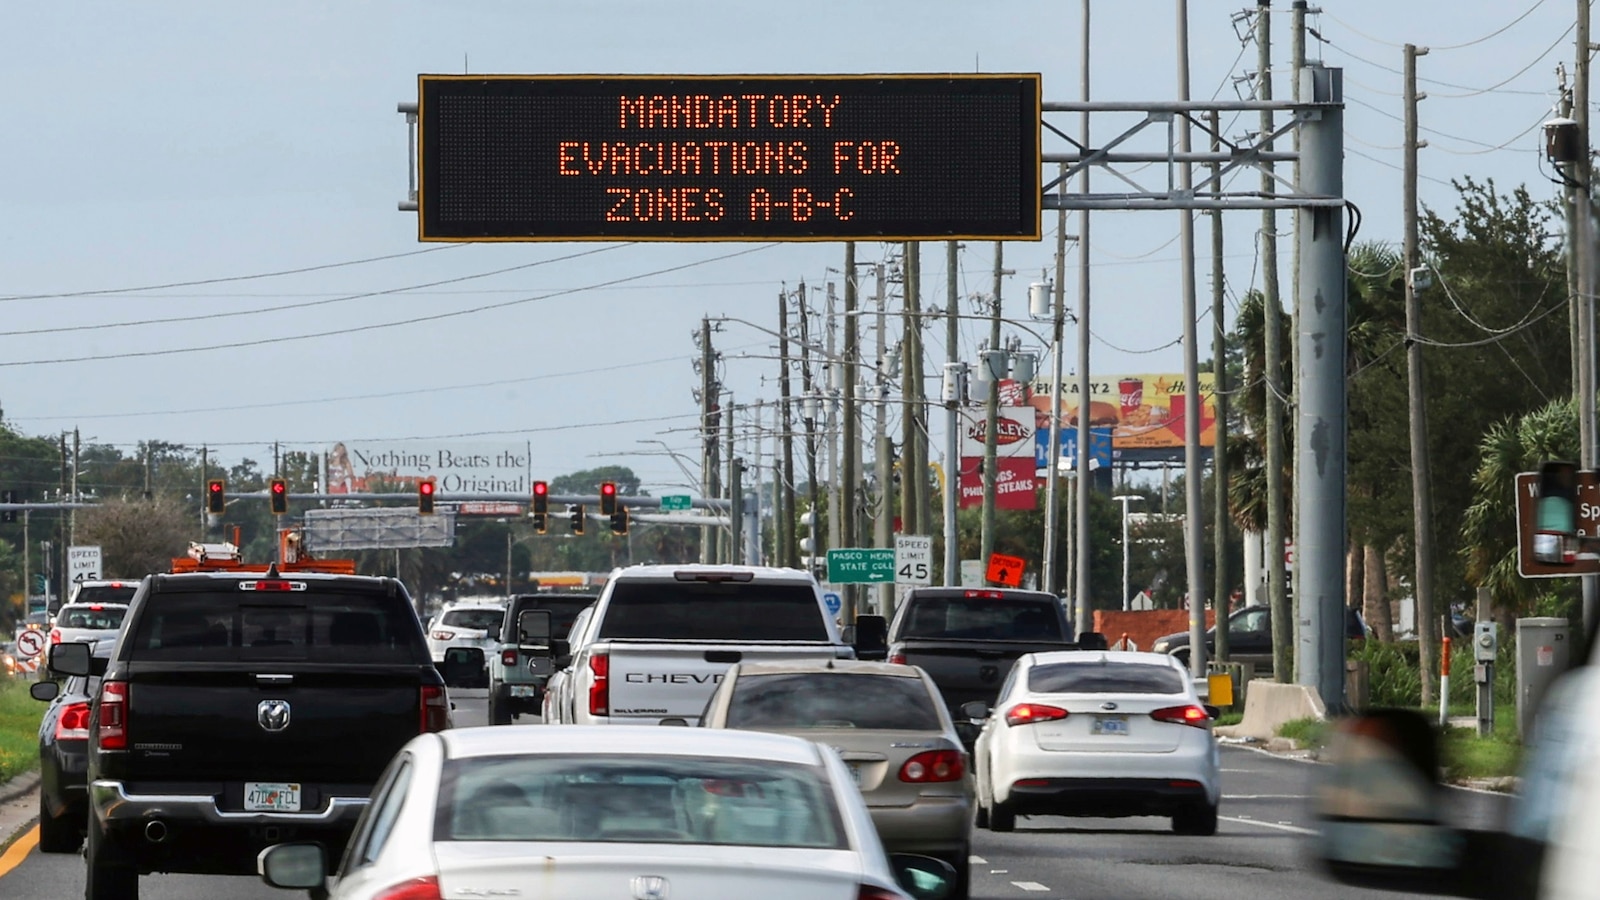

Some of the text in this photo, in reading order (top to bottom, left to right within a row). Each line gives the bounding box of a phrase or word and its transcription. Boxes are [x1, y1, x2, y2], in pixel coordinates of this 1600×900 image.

[619, 94, 841, 129] MANDATORY
[559, 141, 901, 175] EVACUATIONS FOR
[606, 187, 854, 222] ZONES A-B-C
[1070, 383, 1099, 394] AY
[1102, 383, 1110, 393] 2
[967, 422, 1031, 439] CHRLEYS
[353, 449, 526, 473] Nothing Beats the
[442, 473, 523, 494] Original
[963, 479, 1034, 498] PHIL STEAKS
[898, 540, 929, 549] SPEED
[71, 551, 98, 559] SPEED
[832, 552, 863, 560] PASCO
[901, 552, 925, 560] LIMIT
[74, 561, 96, 569] LIMIT
[840, 562, 894, 571] STATE COLL
[898, 563, 928, 579] 45
